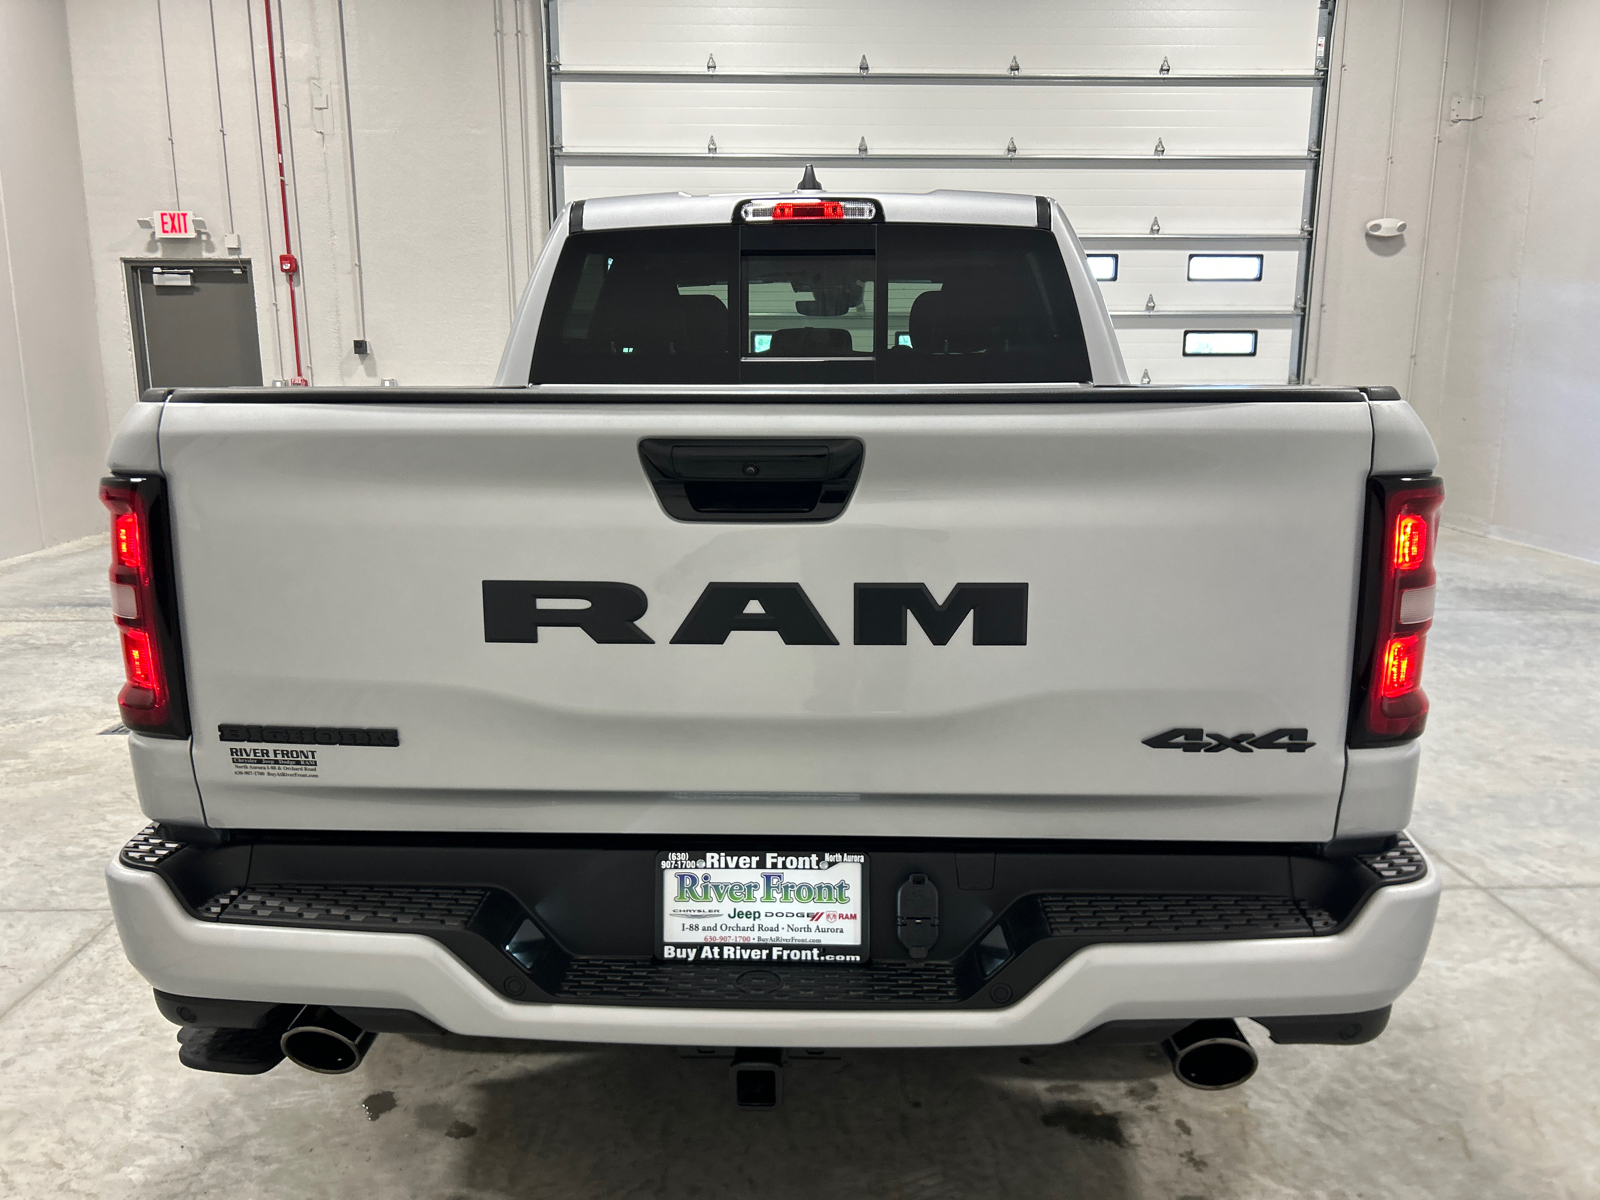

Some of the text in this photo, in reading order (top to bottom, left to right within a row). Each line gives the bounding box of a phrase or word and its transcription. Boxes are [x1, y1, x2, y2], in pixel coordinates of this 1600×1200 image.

[160, 212, 188, 234] EXIT
[482, 580, 1029, 646] RAM
[218, 724, 400, 747] BIGHORN
[1141, 728, 1317, 753] 4x4
[229, 747, 317, 760] RIVER FRONT
[668, 852, 689, 861] (630)
[706, 852, 819, 869] River Front
[824, 852, 865, 863] North Aurora
[661, 860, 696, 869] 907-1700
[674, 872, 851, 904] River Front
[727, 907, 762, 921] Jeep
[681, 923, 844, 934] I-88 and Orchard Road North Aurora
[757, 936, 822, 944] BuyAtRiverFront.com
[663, 945, 861, 961] Buy At River Front.com
